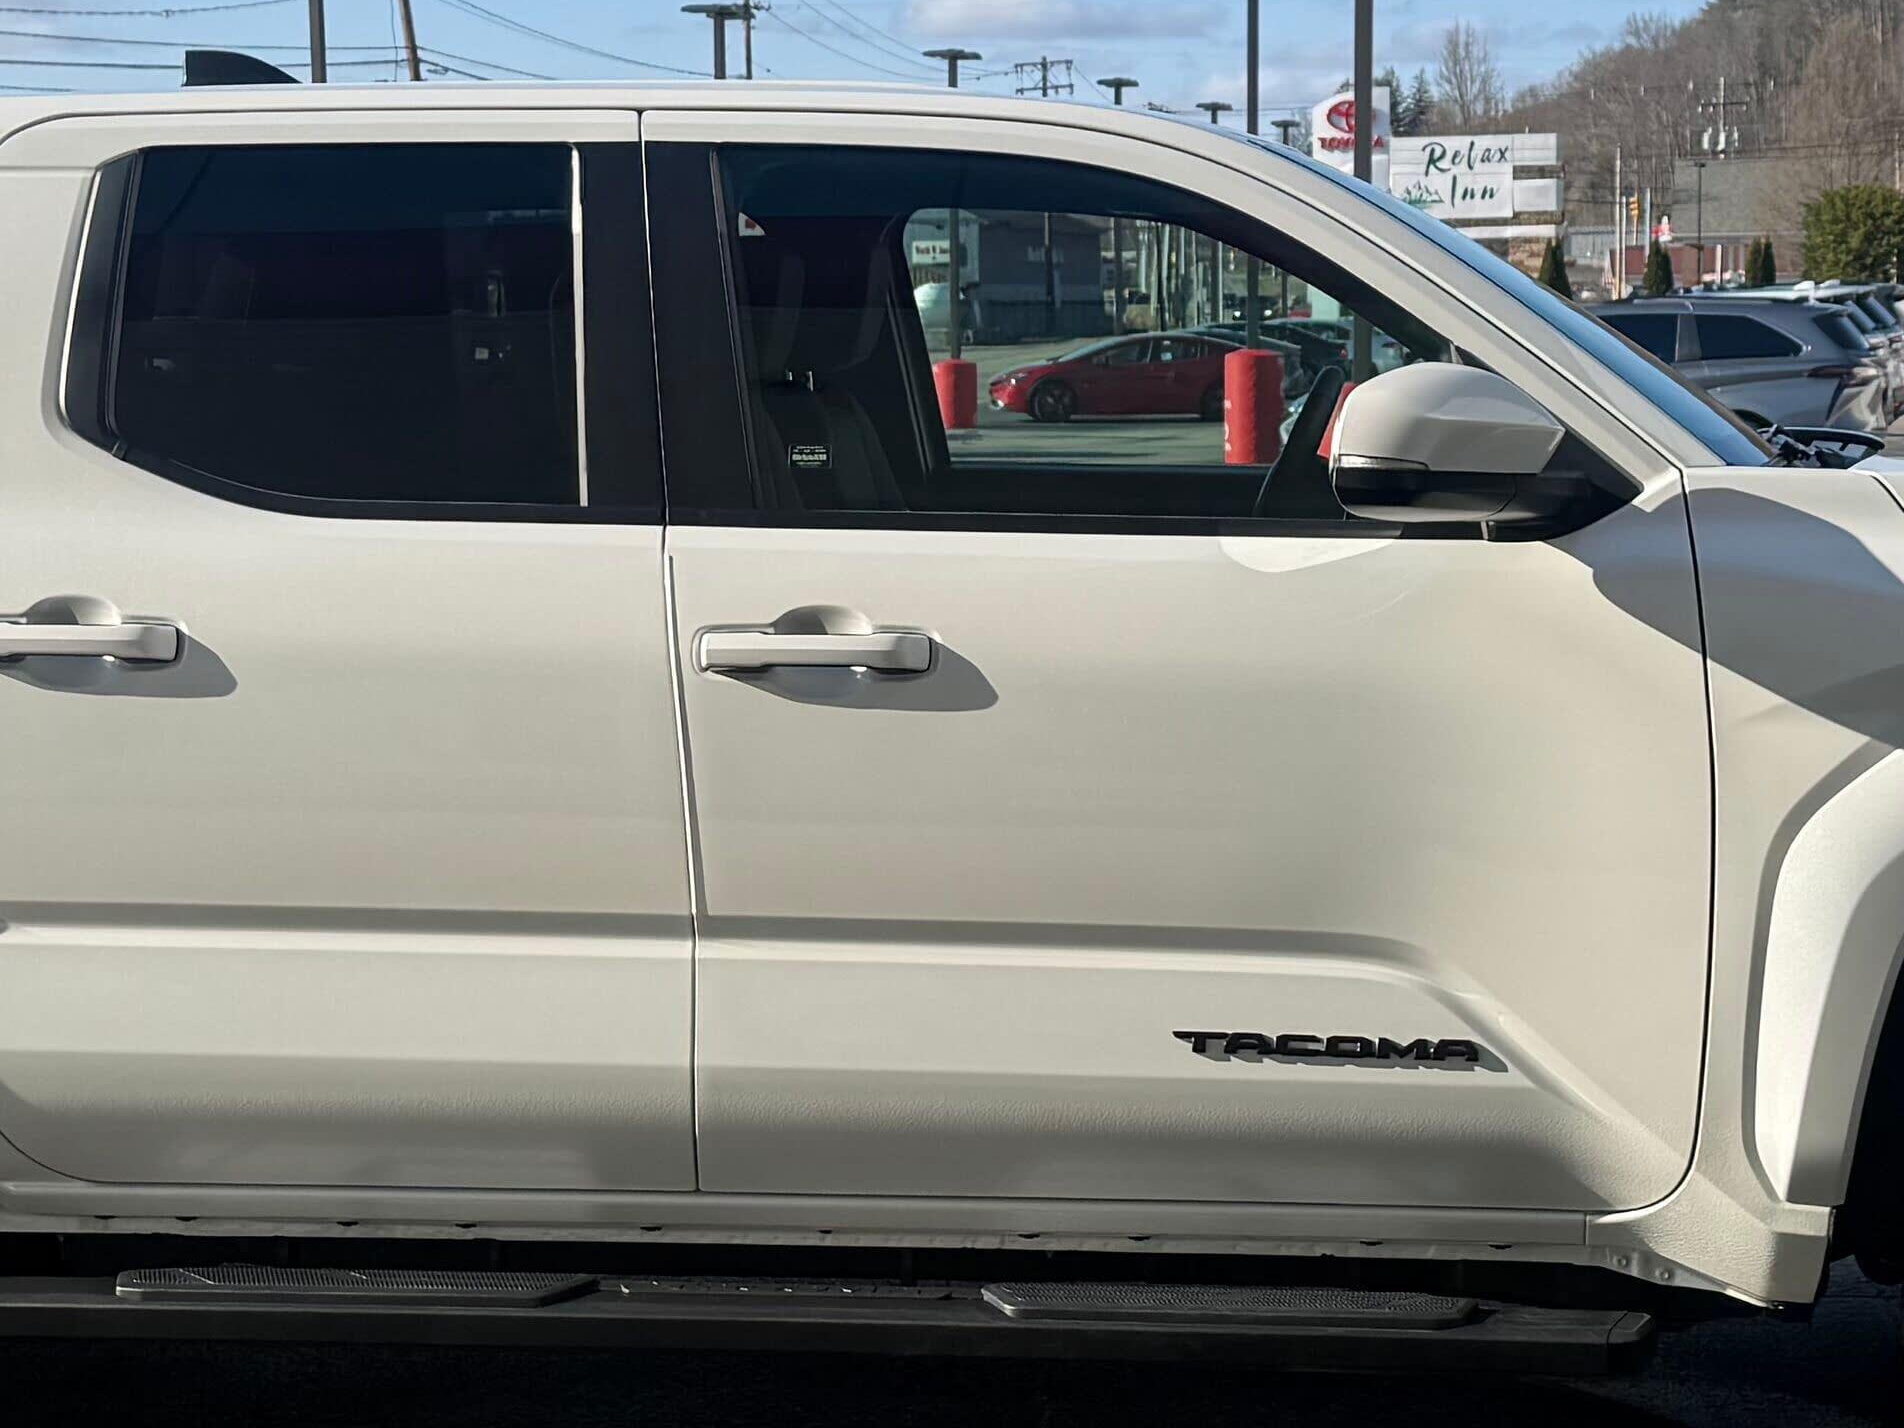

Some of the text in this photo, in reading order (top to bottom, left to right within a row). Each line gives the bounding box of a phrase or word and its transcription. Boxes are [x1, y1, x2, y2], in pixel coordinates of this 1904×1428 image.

[1422, 140, 1509, 177] Relax
[1450, 175, 1501, 208] Inn
[1172, 1030, 1480, 1062] TACOMA
